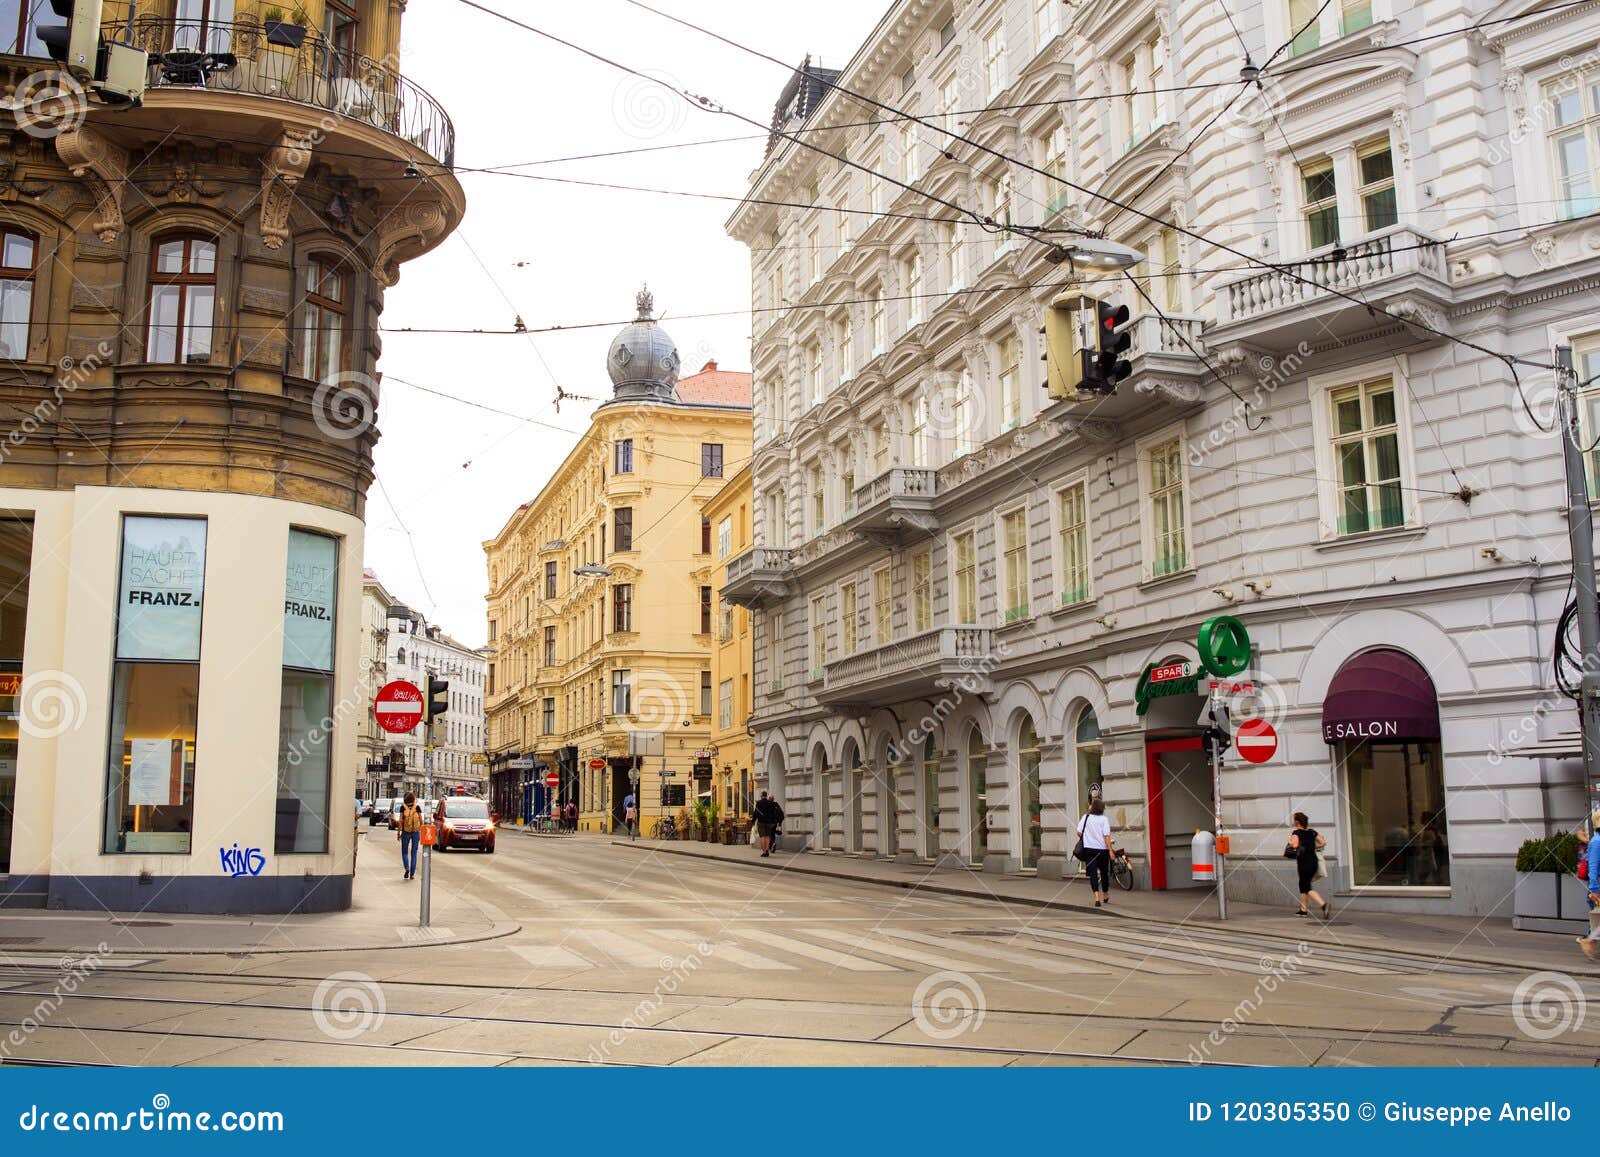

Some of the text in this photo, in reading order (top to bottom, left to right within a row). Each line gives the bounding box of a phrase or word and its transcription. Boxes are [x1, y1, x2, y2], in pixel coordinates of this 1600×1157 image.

[131, 550, 196, 566] HAUPT
[130, 567, 194, 584] SACHE
[128, 590, 200, 607] FRANZ.
[284, 600, 331, 621] FRANZ.
[1156, 666, 1182, 679] SPAR
[1336, 721, 1397, 738] SALON
